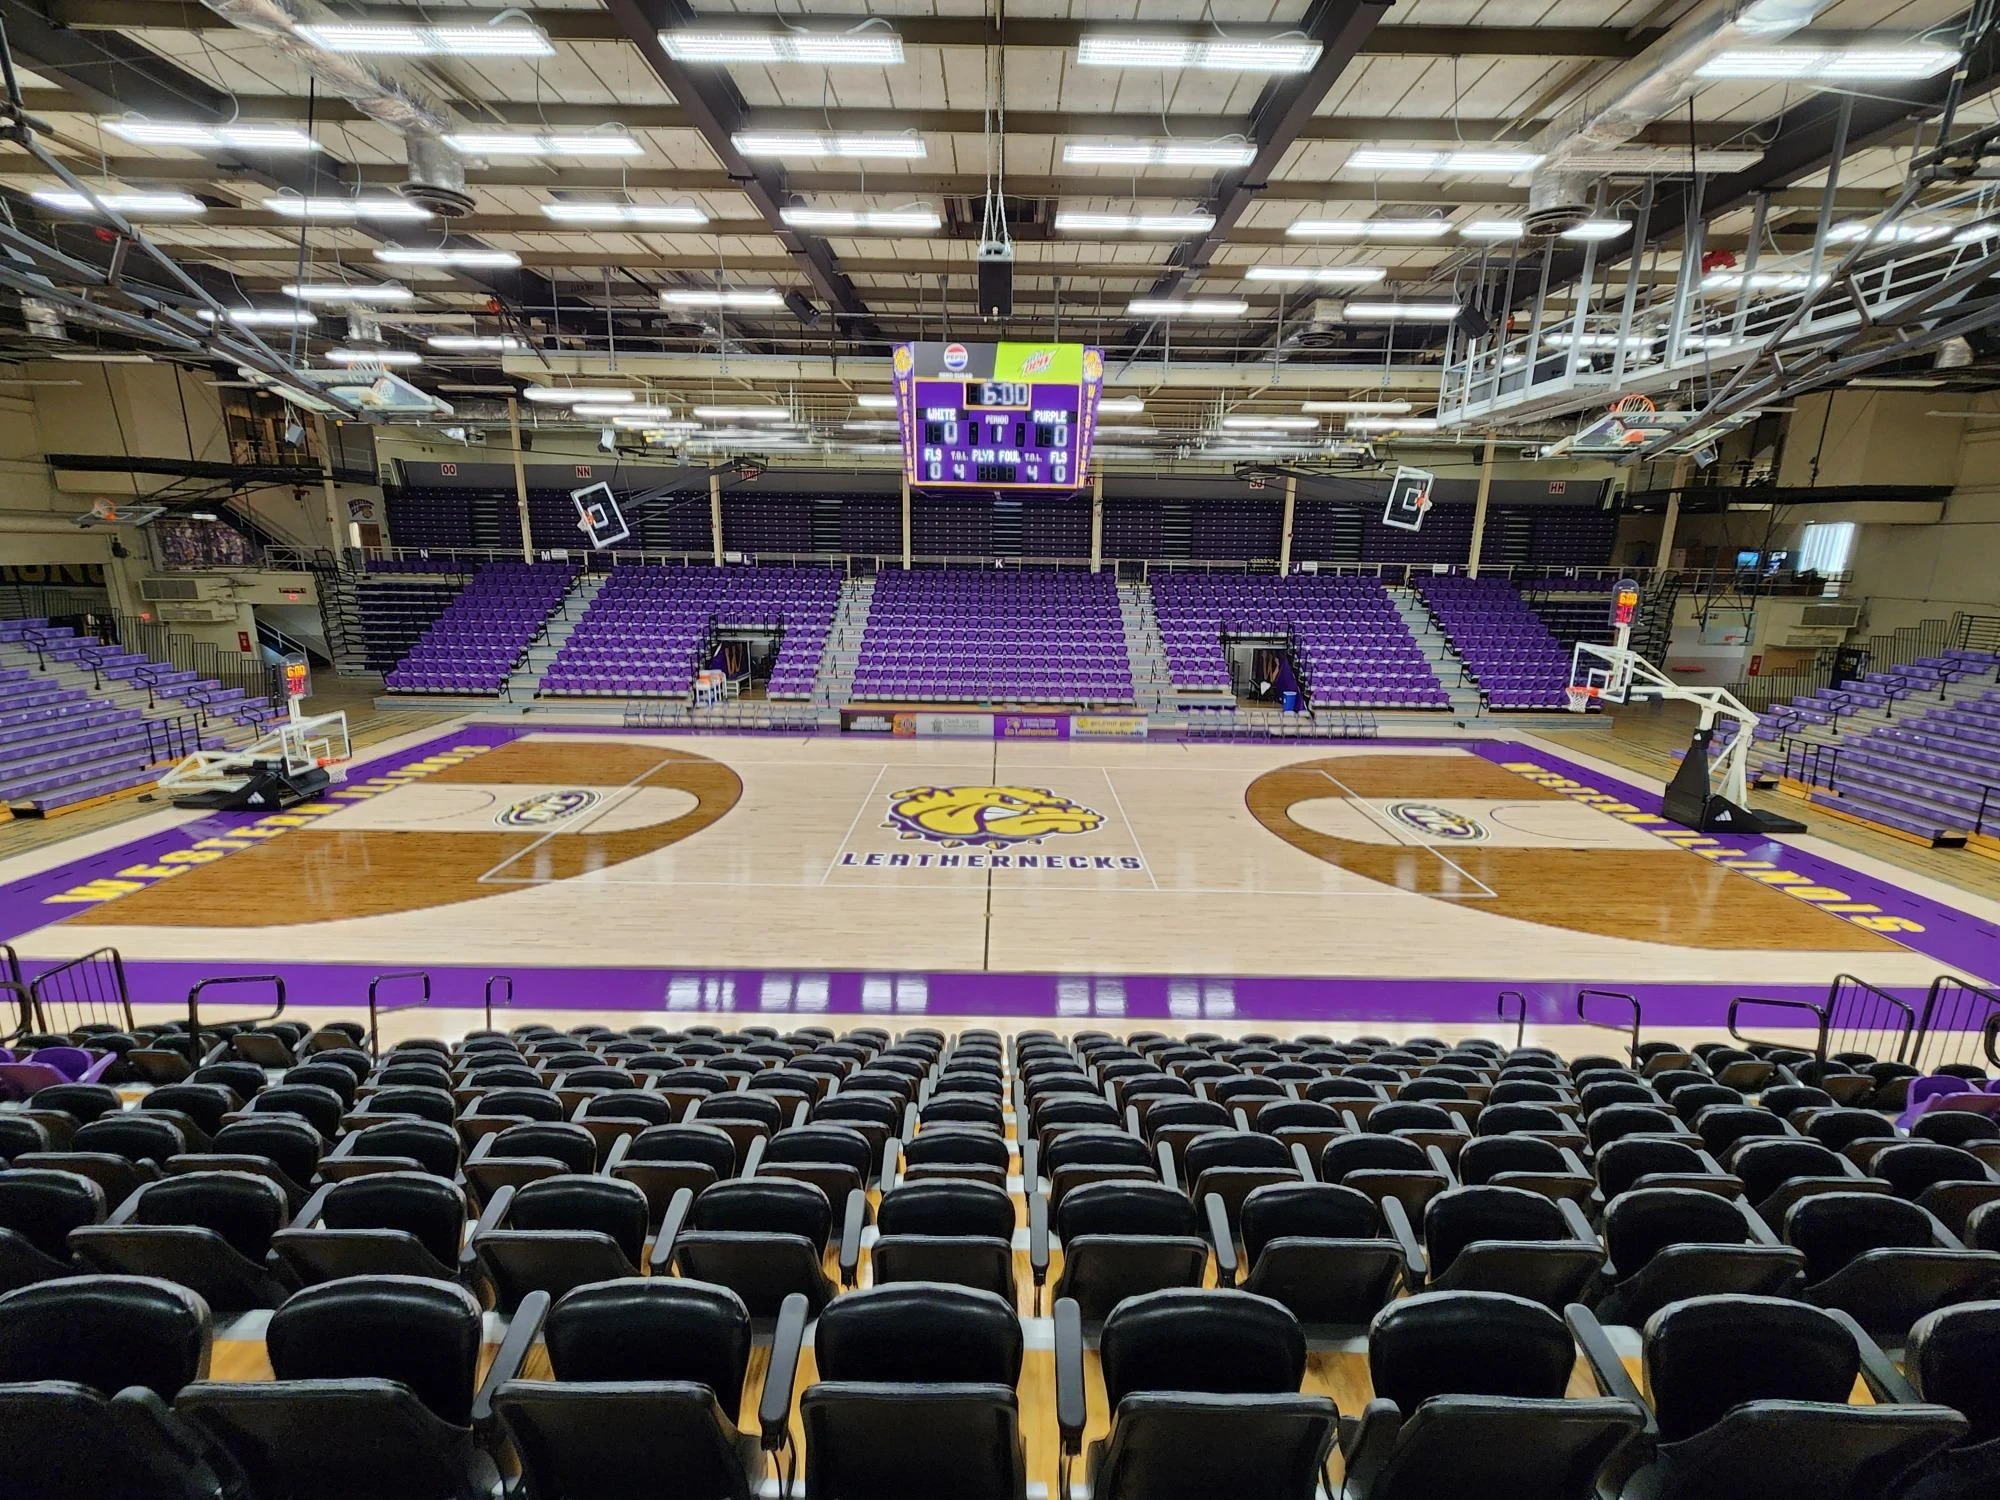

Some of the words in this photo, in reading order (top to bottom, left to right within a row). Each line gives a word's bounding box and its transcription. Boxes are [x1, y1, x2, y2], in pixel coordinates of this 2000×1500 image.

[927, 408, 956, 421] WHITE
[985, 415, 1009, 425] PERIOD
[1033, 410, 1068, 424] PURPLE
[943, 422, 958, 445] 0
[1053, 424, 1068, 447] 0
[925, 448, 942, 461] FLS
[971, 449, 995, 462] PLYR
[998, 450, 1021, 463] FOUL
[1050, 451, 1067, 464] FLS
[930, 462, 942, 480] 0
[953, 463, 965, 479] 4
[1027, 464, 1038, 481] 4
[1054, 464, 1066, 482] 0
[420, 549, 429, 558] N
[540, 550, 551, 561] M
[995, 558, 1004, 569] K
[1565, 567, 1574, 577] H
[40, 803, 345, 904] WESTERN
[330, 745, 491, 799] ILLINOIS
[1500, 762, 1669, 824] WESTERN
[1650, 830, 1926, 932] ILLINOIS
[841, 853, 1142, 870] LEATHERNECKS
